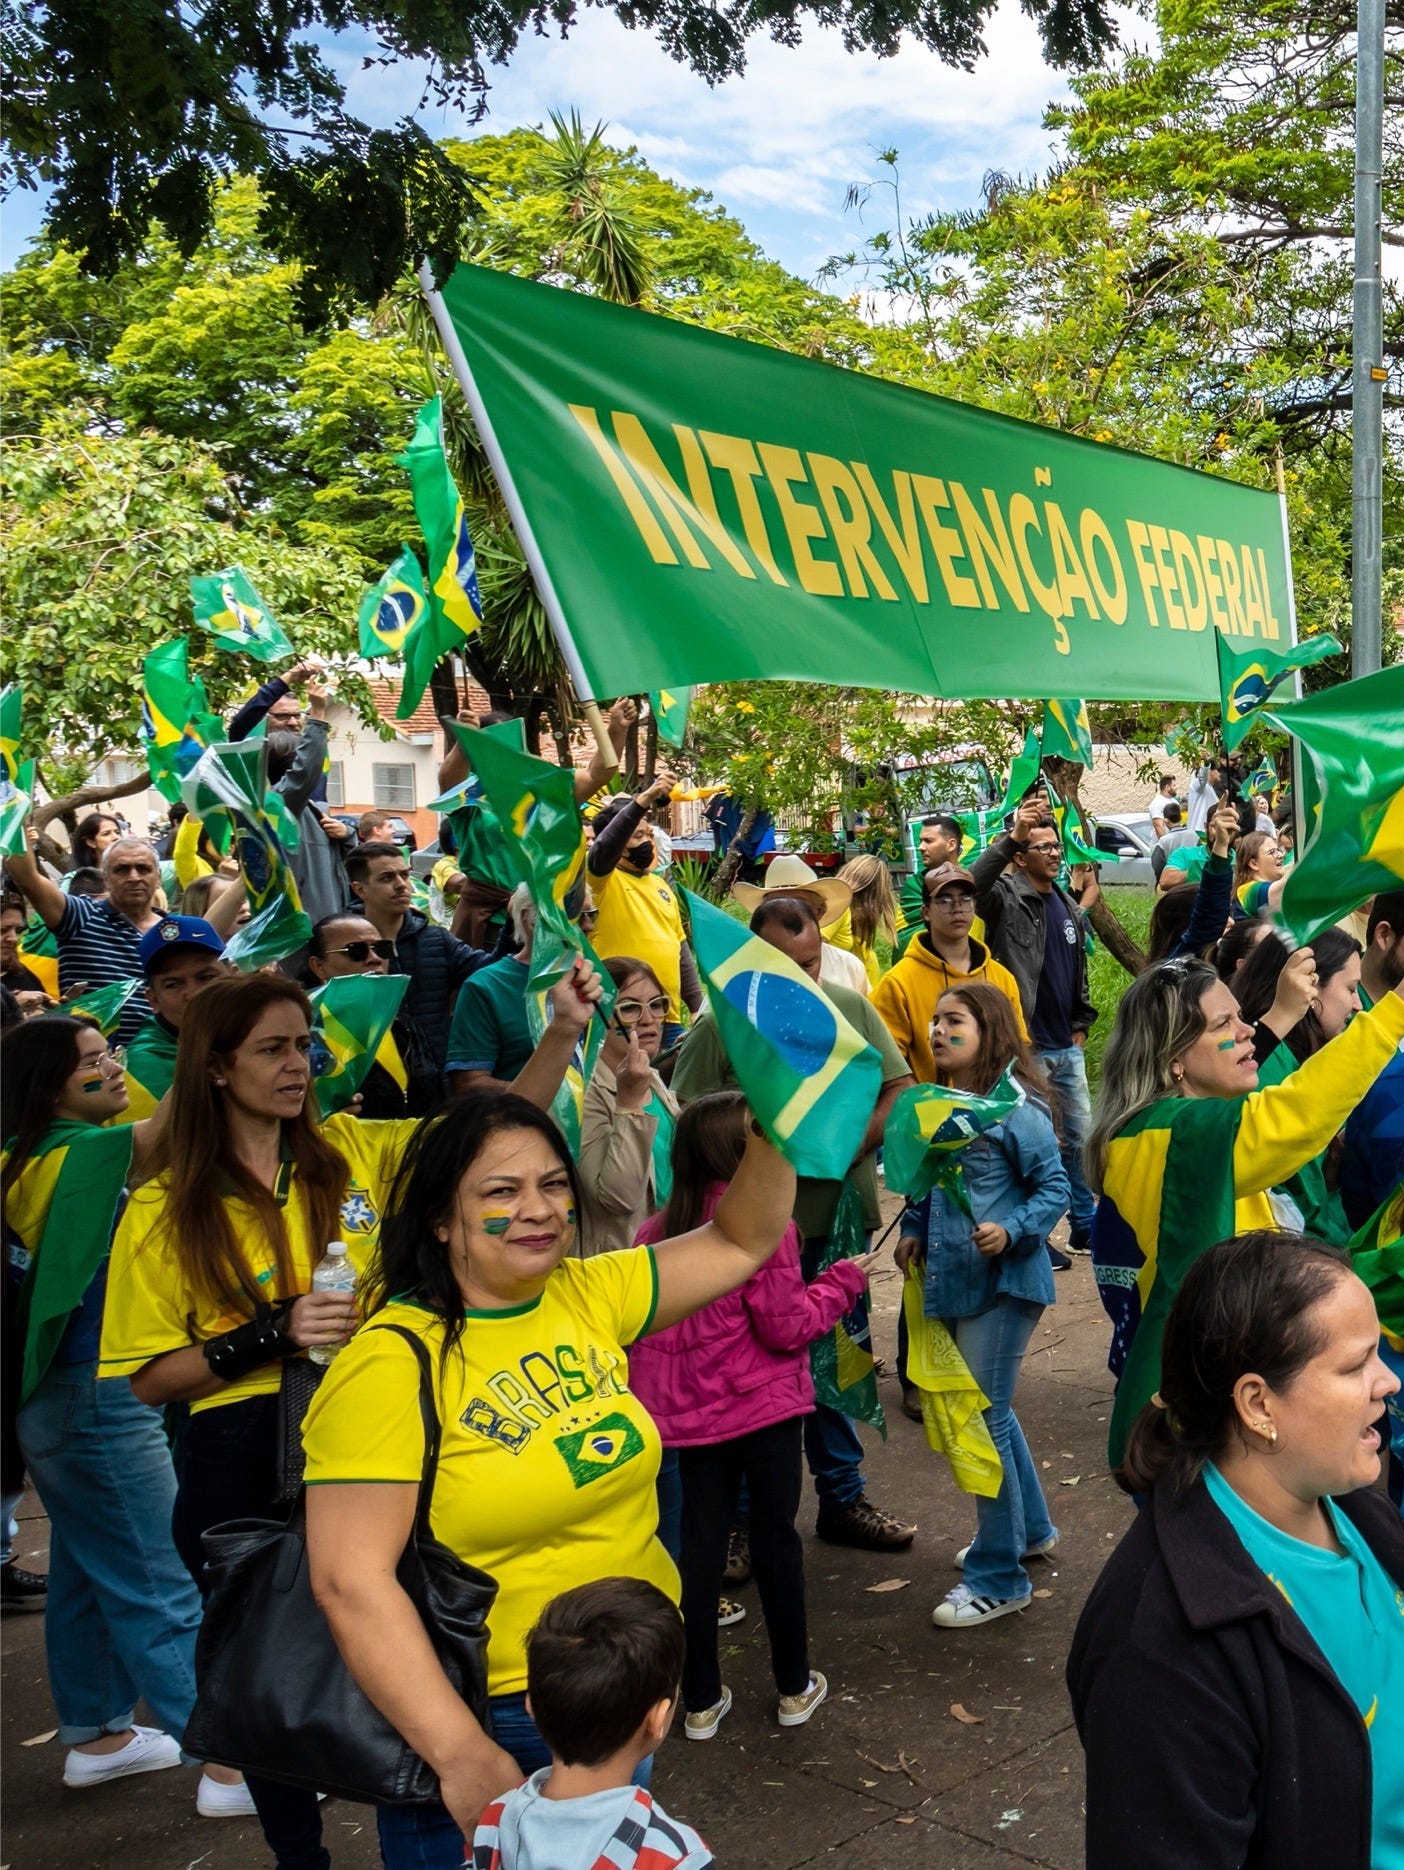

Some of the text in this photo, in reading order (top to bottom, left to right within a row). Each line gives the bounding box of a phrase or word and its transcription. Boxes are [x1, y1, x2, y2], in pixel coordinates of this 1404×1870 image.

[569, 404, 1279, 655] INTERVENÇÃO FEDERAL
[459, 1344, 628, 1456] BRASIL
